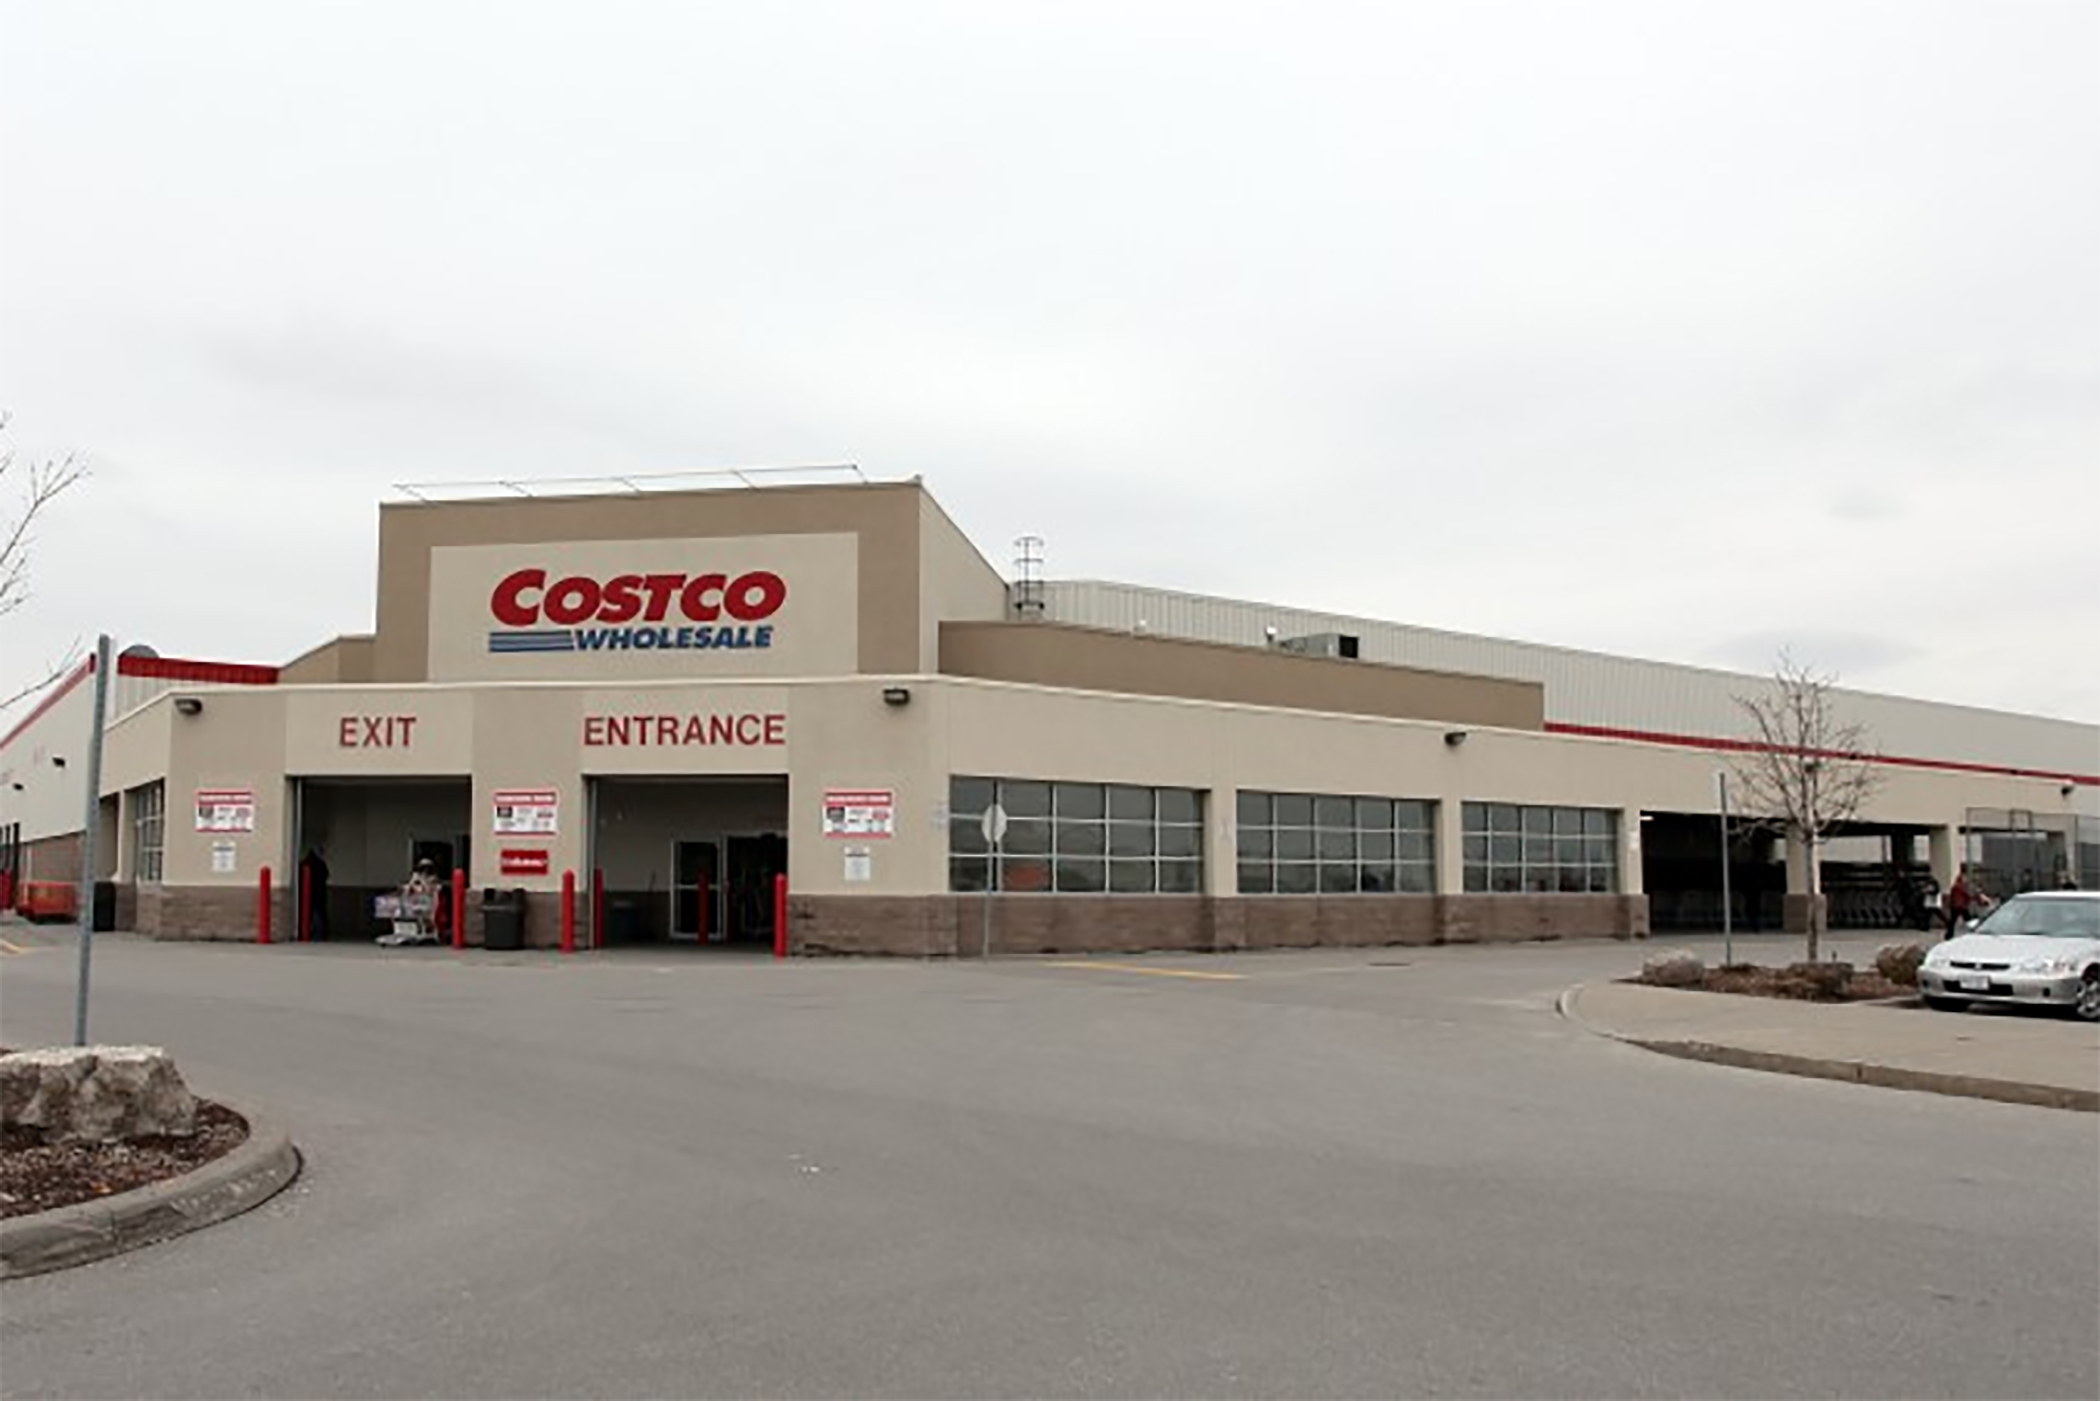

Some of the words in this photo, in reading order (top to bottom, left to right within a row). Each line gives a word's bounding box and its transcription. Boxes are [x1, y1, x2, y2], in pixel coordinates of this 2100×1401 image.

[491, 568, 787, 627] COSTCO
[576, 625, 774, 651] WHOLESALE
[338, 716, 417, 748] EXIT
[582, 714, 786, 746] ENTRANCE
